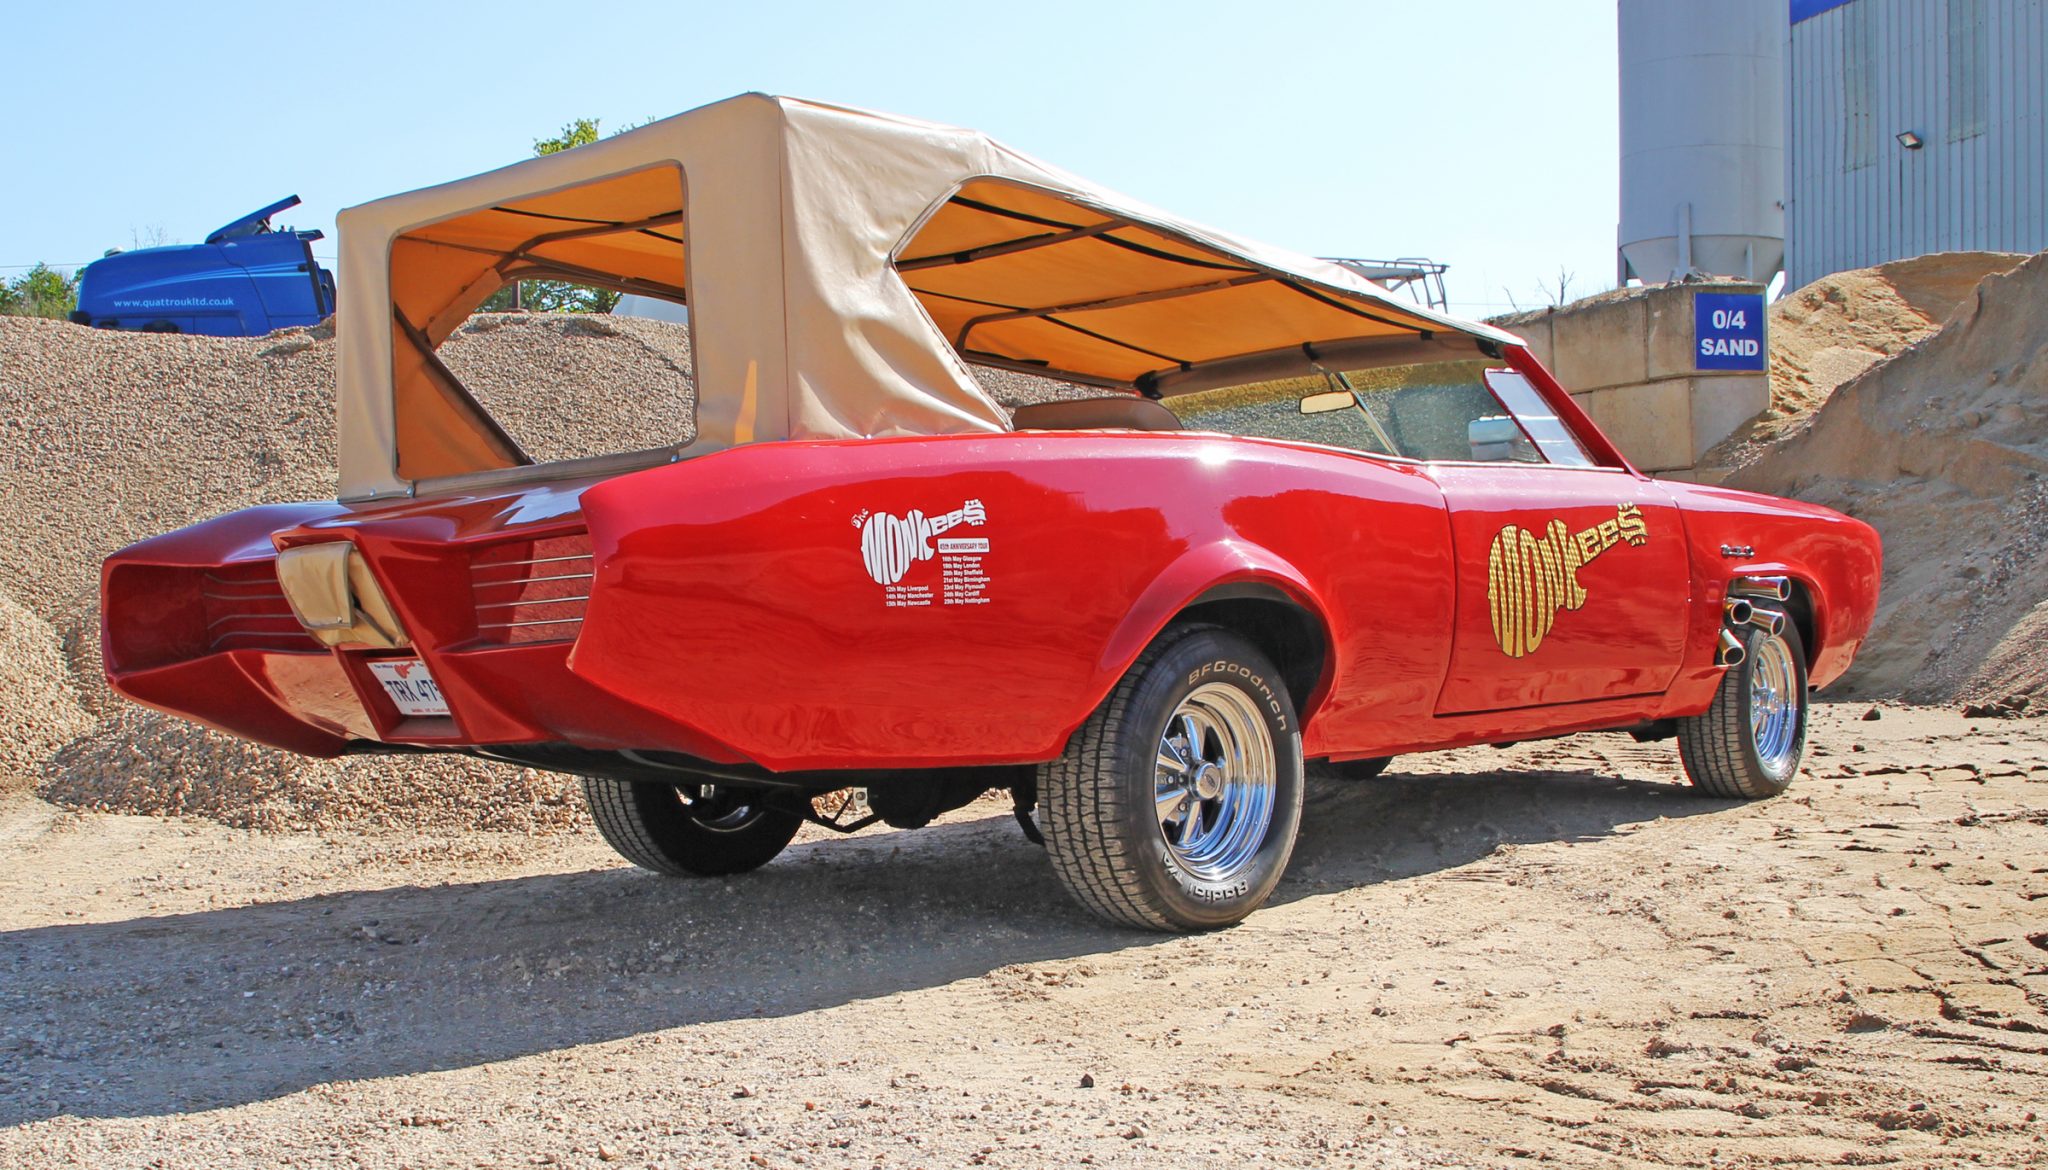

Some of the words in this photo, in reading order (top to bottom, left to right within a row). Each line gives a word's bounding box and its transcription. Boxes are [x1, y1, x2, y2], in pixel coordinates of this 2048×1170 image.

[114, 296, 234, 308] www.quattroukltd.co.uk
[1712, 309, 1746, 330] 0/4
[1701, 338, 1759, 356] SAND
[907, 585, 929, 593] Liverpool
[385, 680, 420, 701] TRX
[1188, 660, 1287, 731] BFGoodrich
[1188, 879, 1249, 903] Radial
